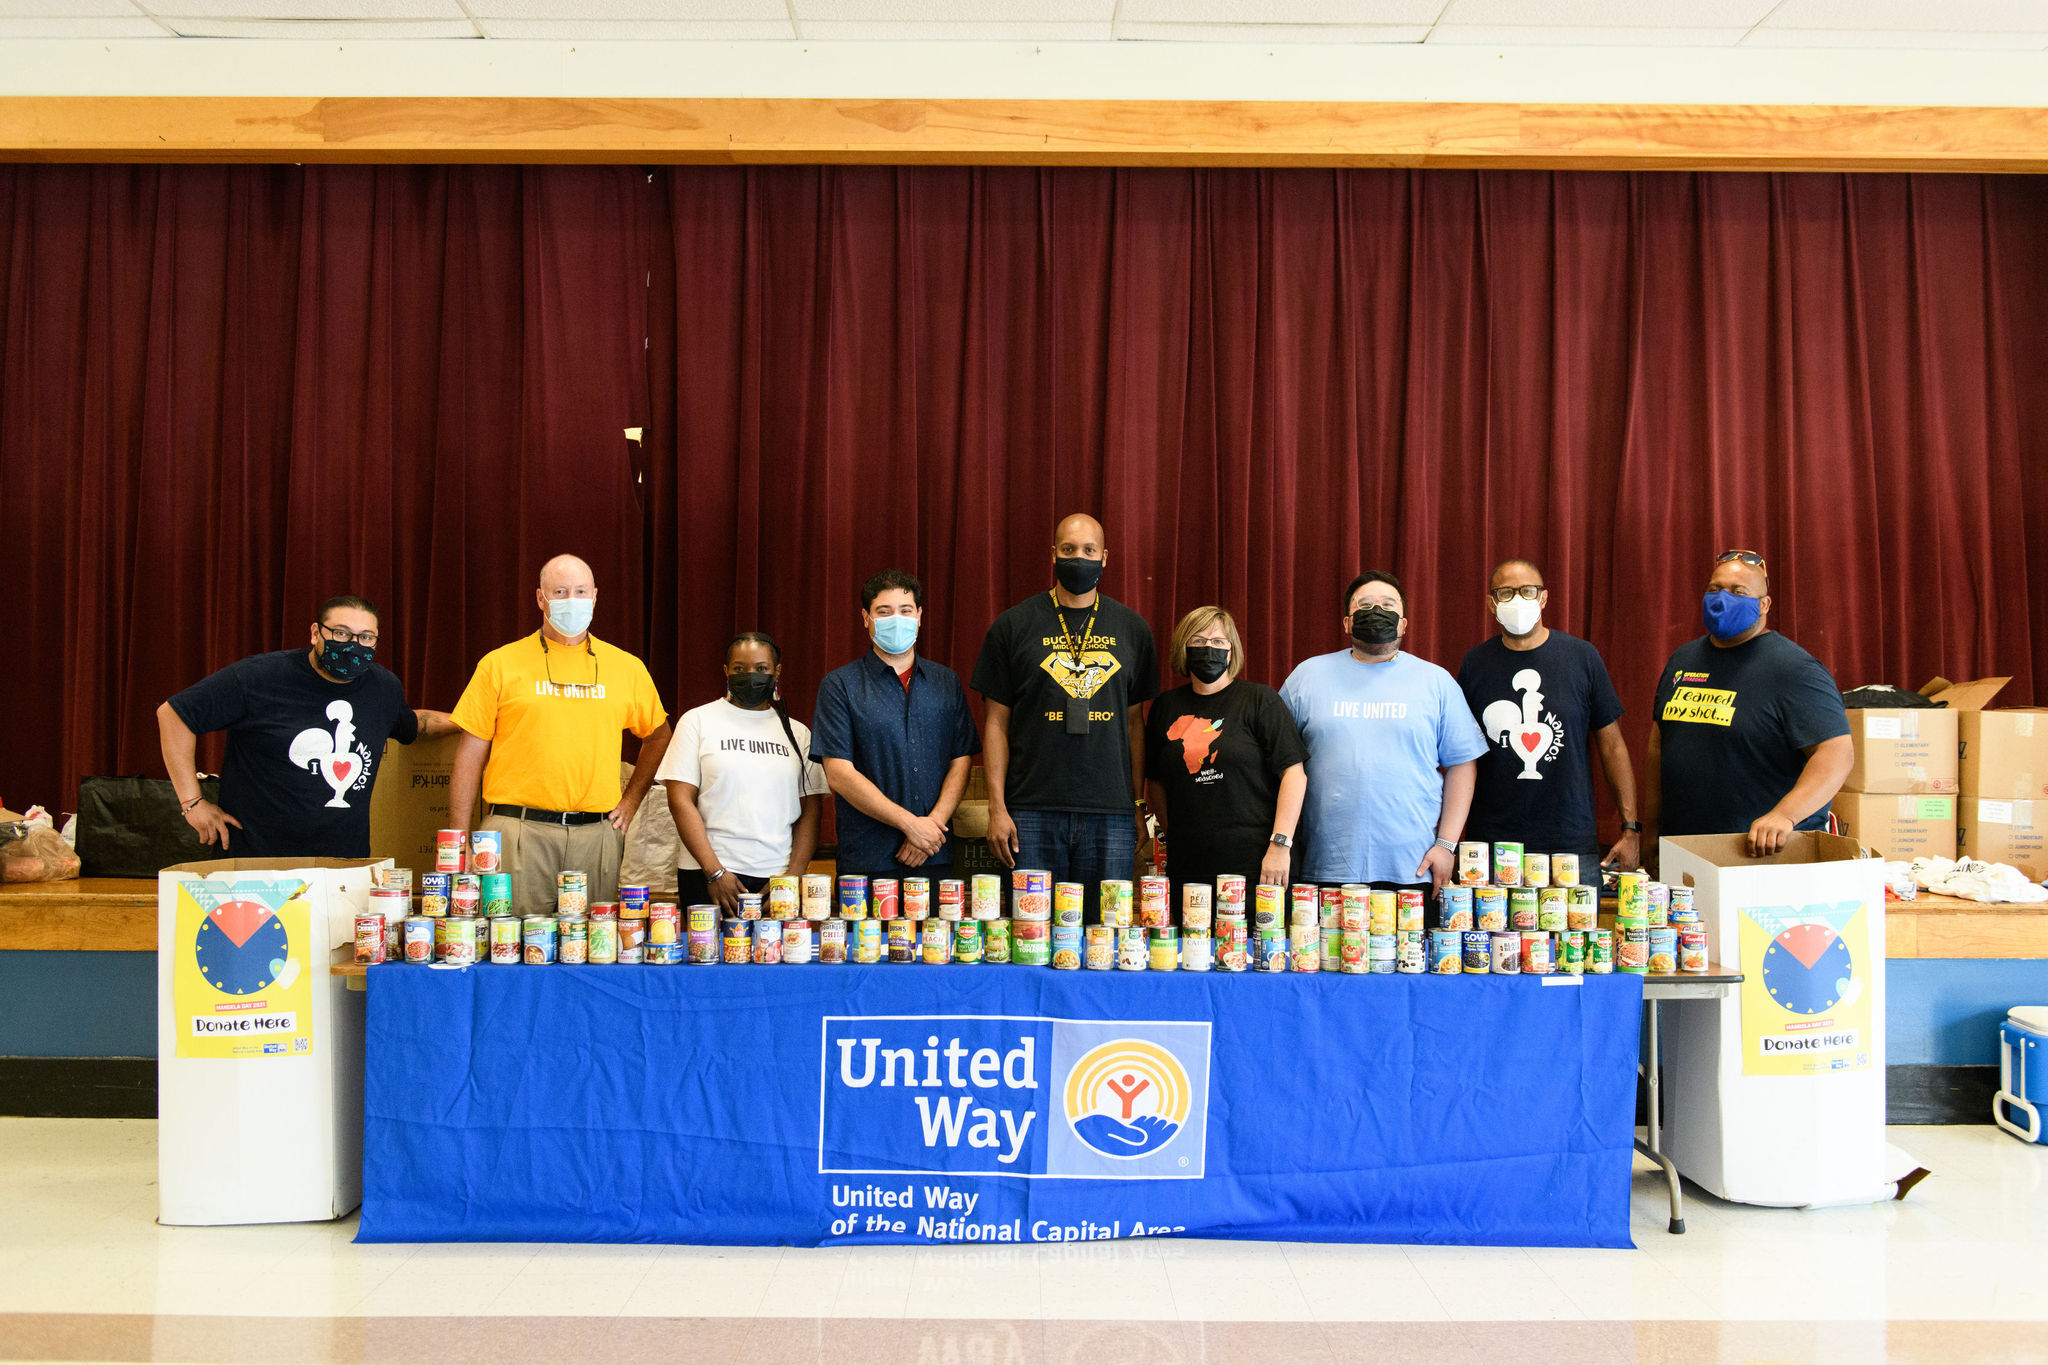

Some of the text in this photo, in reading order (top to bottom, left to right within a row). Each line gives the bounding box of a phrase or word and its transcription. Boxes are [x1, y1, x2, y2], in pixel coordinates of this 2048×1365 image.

[1043, 635, 1075, 646] BUC
[535, 680, 606, 699] LIVE UNITED
[1674, 688, 1682, 700] I
[1333, 700, 1408, 719] LIVE UNITED
[1665, 706, 1687, 718] my
[1501, 712, 1564, 762] I Nando's
[720, 738, 790, 757] LIVE UNITED
[311, 742, 372, 791] I Nando's
[965, 845, 995, 858] HE
[964, 860, 1001, 868] SELEC
[1464, 933, 1489, 941] GOYA
[196, 1017, 291, 1032] Donate Here
[1764, 1034, 1854, 1051] Donate Here
[837, 1035, 1039, 1089] United
[914, 1096, 1036, 1164] Way
[832, 1185, 979, 1216] United Way
[831, 1214, 859, 1236] of
[866, 1215, 907, 1233] the
[917, 1216, 1021, 1242] National
[1032, 1220, 1120, 1242] Capital
